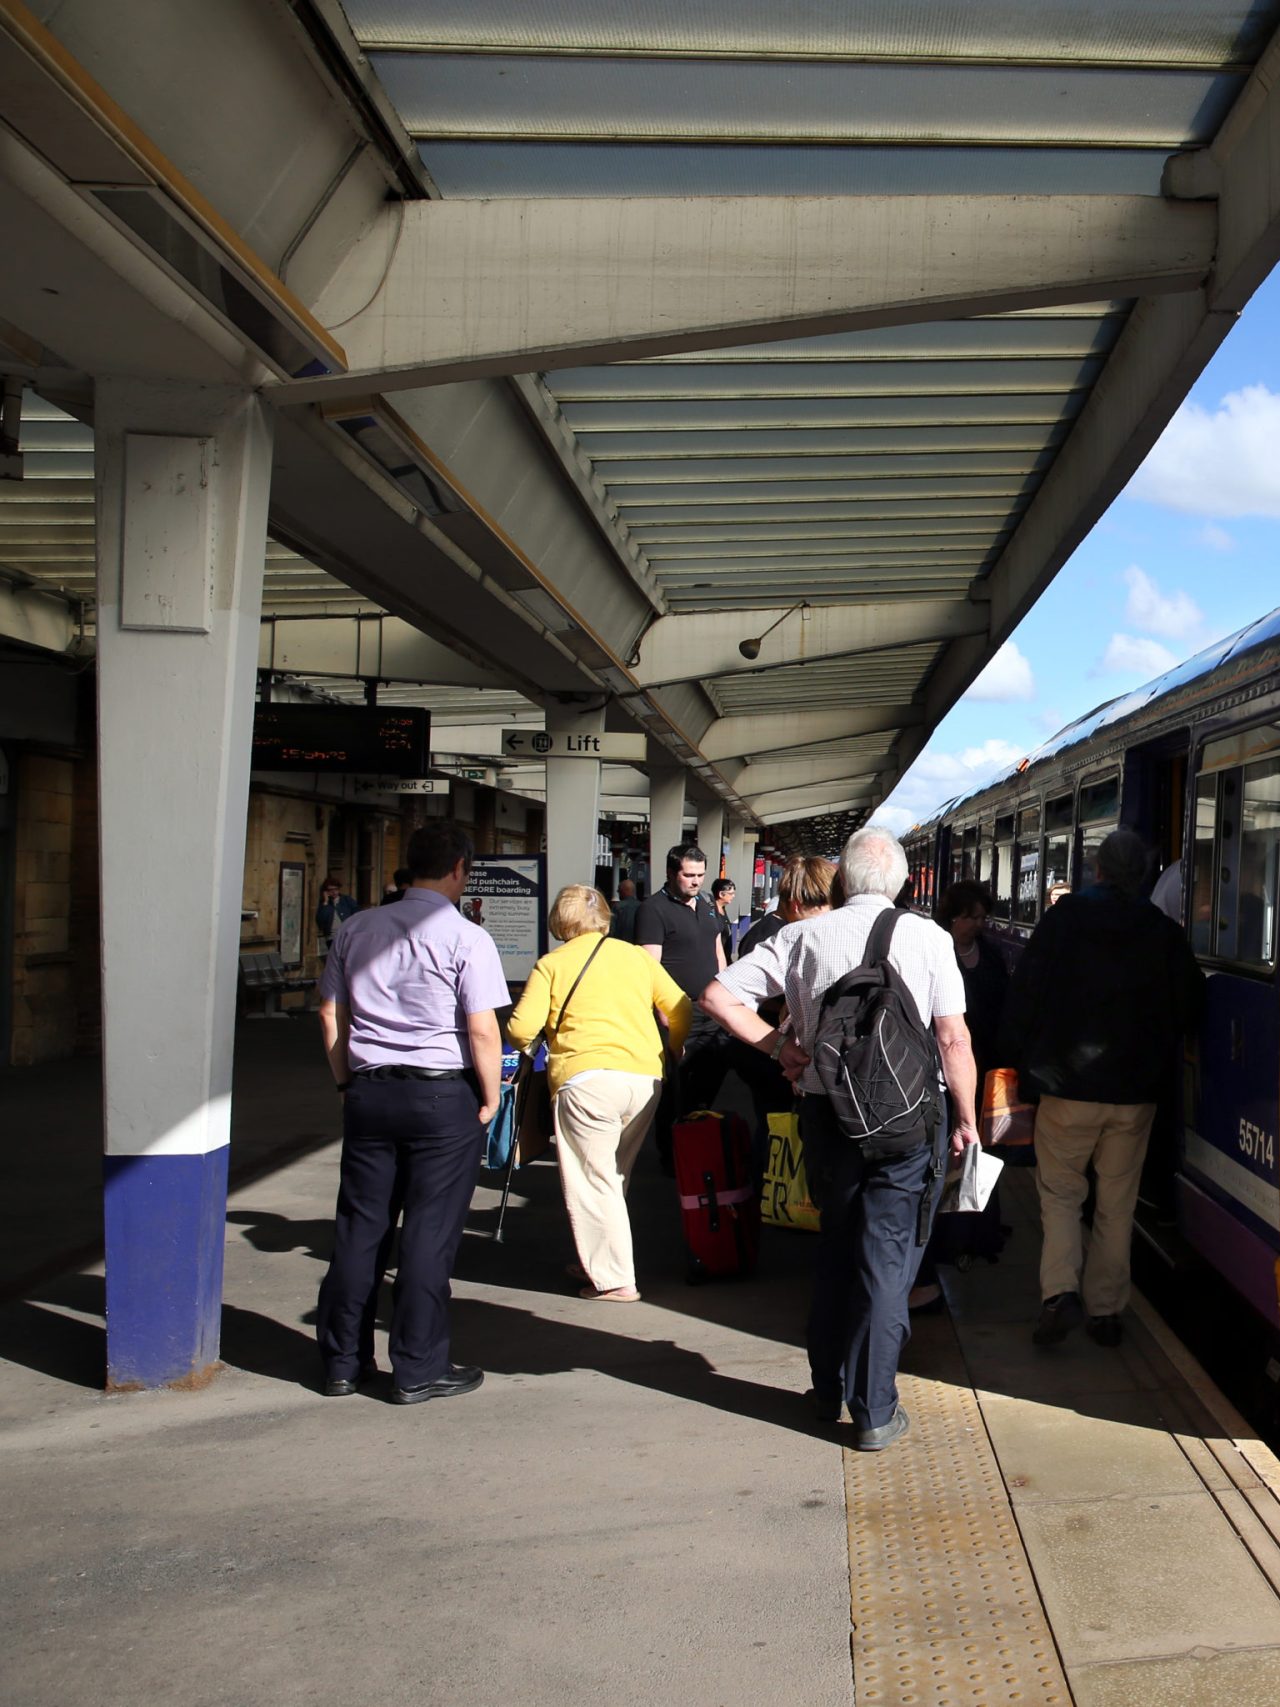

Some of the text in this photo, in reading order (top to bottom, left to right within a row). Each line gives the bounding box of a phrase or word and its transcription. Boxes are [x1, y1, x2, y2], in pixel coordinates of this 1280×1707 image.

[567, 735, 600, 751] Lift
[377, 782, 417, 791] Way out
[479, 878, 520, 886] pushchairs
[496, 886, 531, 895] boarding
[1239, 1117, 1274, 1169] 55714
